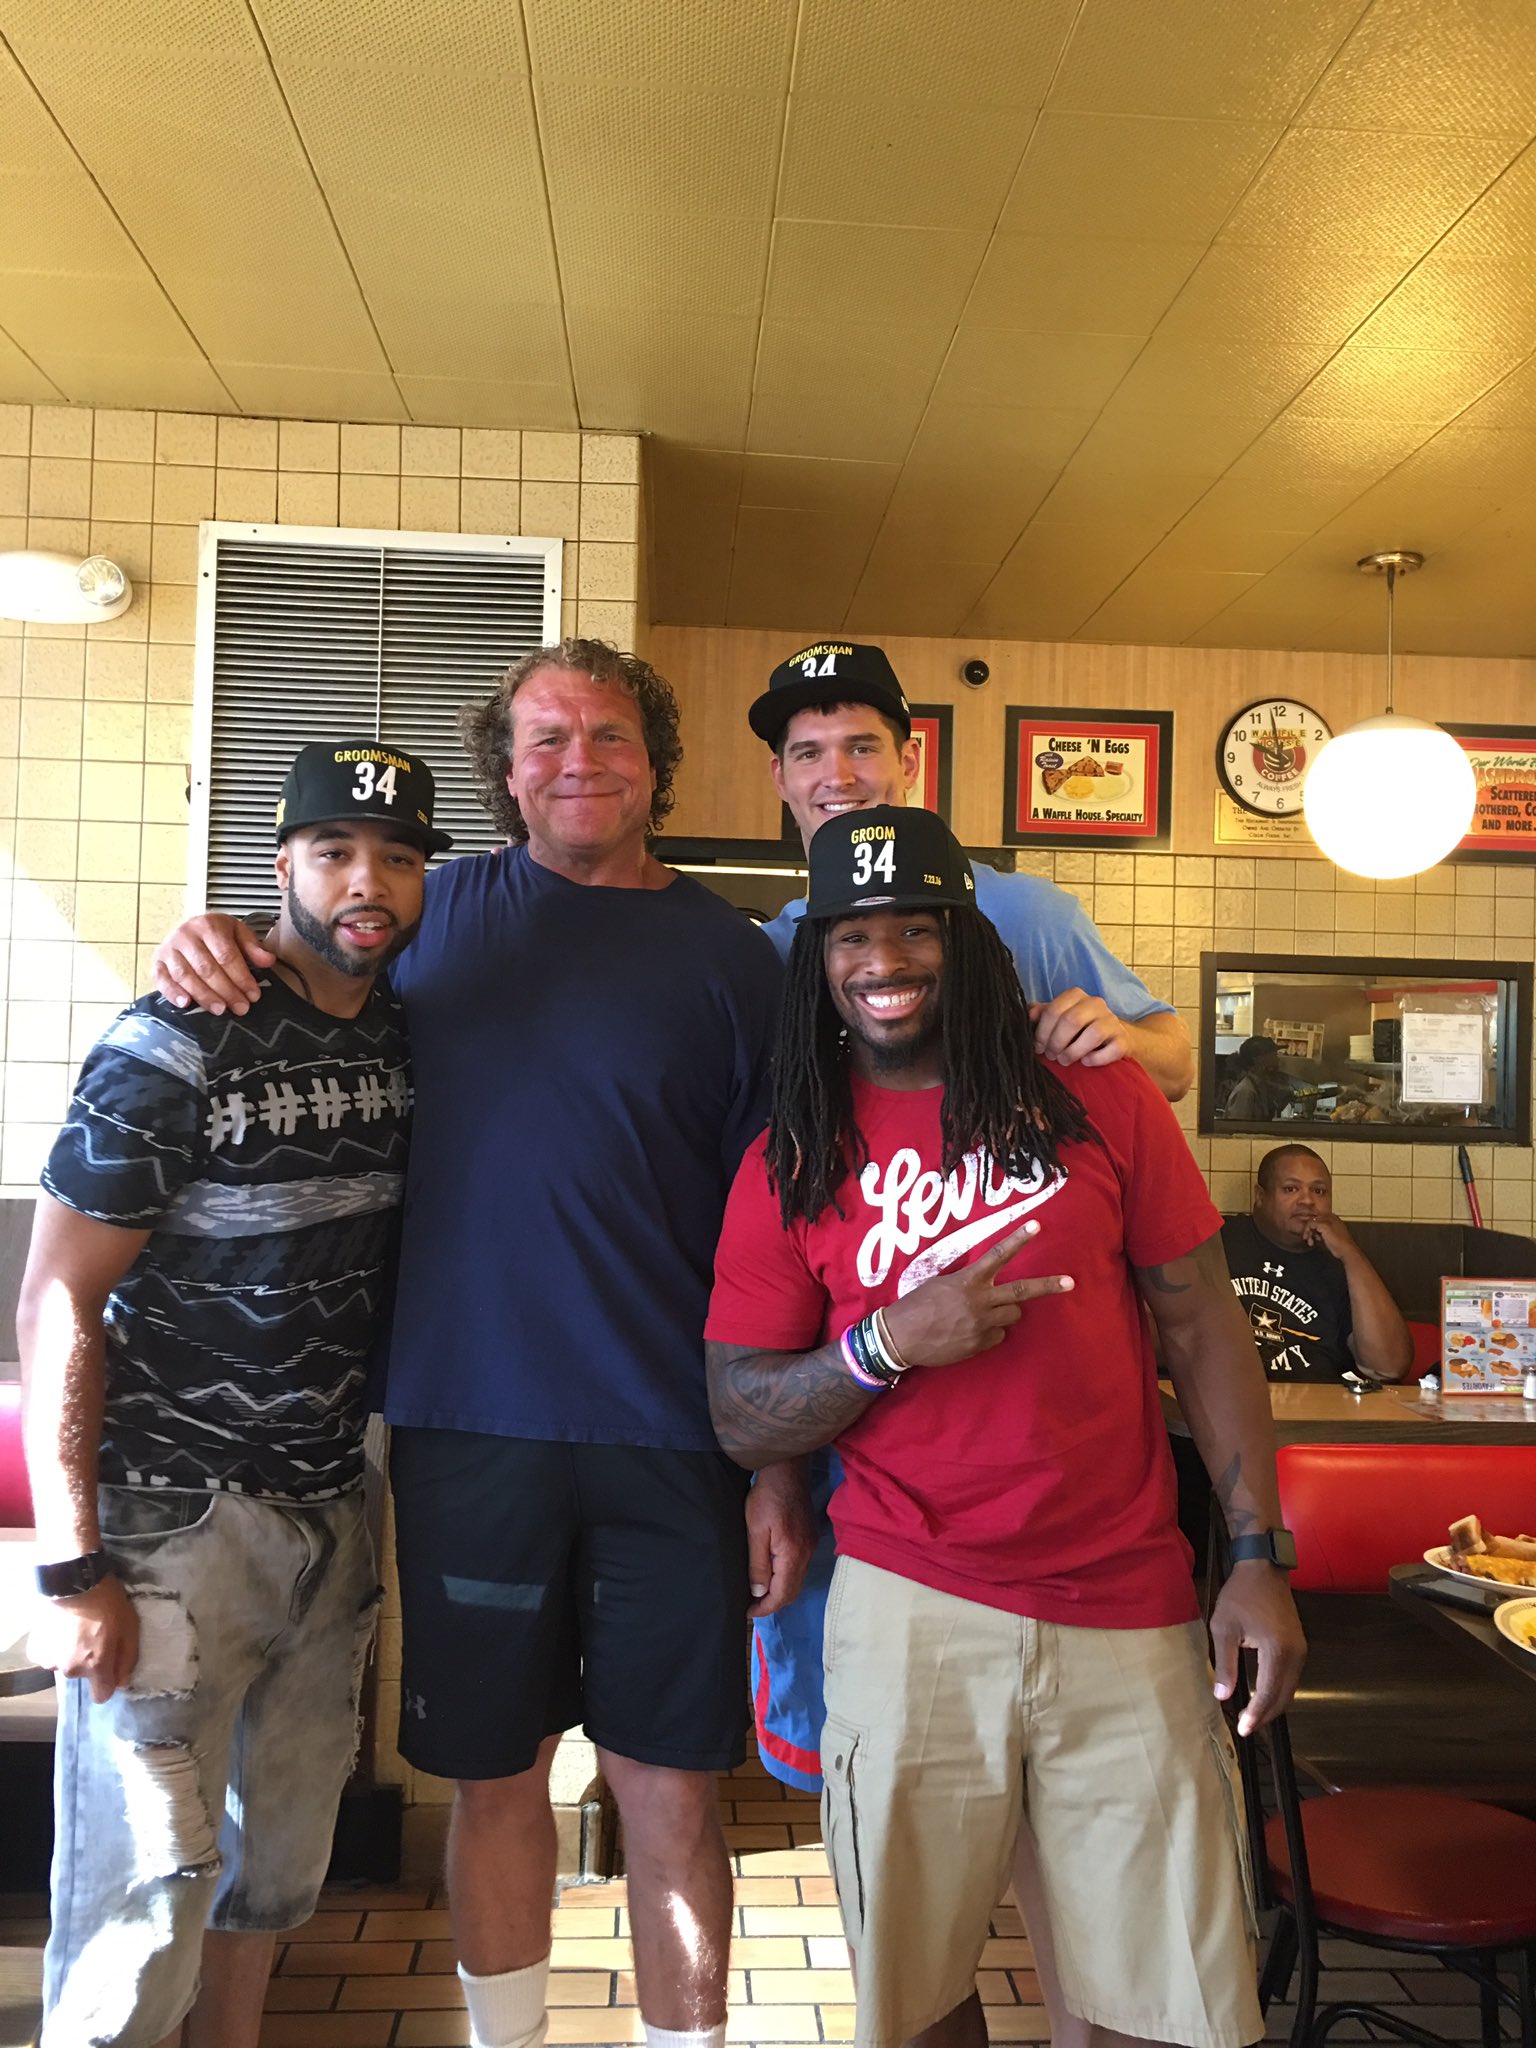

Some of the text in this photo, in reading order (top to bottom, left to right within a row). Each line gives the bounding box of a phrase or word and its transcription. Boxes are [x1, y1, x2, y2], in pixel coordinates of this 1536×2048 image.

[788, 645, 853, 668] GROOMSMAN
[801, 653, 837, 678] 34
[1273, 705, 1286, 717] 12
[1250, 713, 1262, 724] 11
[1298, 712, 1304, 724] 1
[1233, 730, 1247, 742] 10
[1252, 729, 1306, 738] WAFLE
[1314, 729, 1323, 741] 2
[1049, 737, 1082, 752] CHEESE
[1105, 740, 1129, 754] EGGS
[334, 749, 411, 773] GROOMSMAN
[1227, 752, 1236, 763] 9
[1234, 775, 1243, 786] 8
[1260, 767, 1299, 782] COFFEE
[352, 762, 397, 806] 34
[1252, 791, 1260, 803] 7
[1276, 798, 1285, 809] 6
[1032, 807, 1039, 819] A
[1042, 808, 1072, 820] WAFFLE
[1105, 810, 1143, 822] SPECIALTY
[1475, 804, 1521, 817] OTHERED,
[1482, 819, 1501, 830] AND
[851, 825, 896, 844] GROOM
[852, 840, 897, 886] 34
[1231, 1276, 1319, 1325] NITED STATES
[1270, 1344, 1311, 1371] MY
